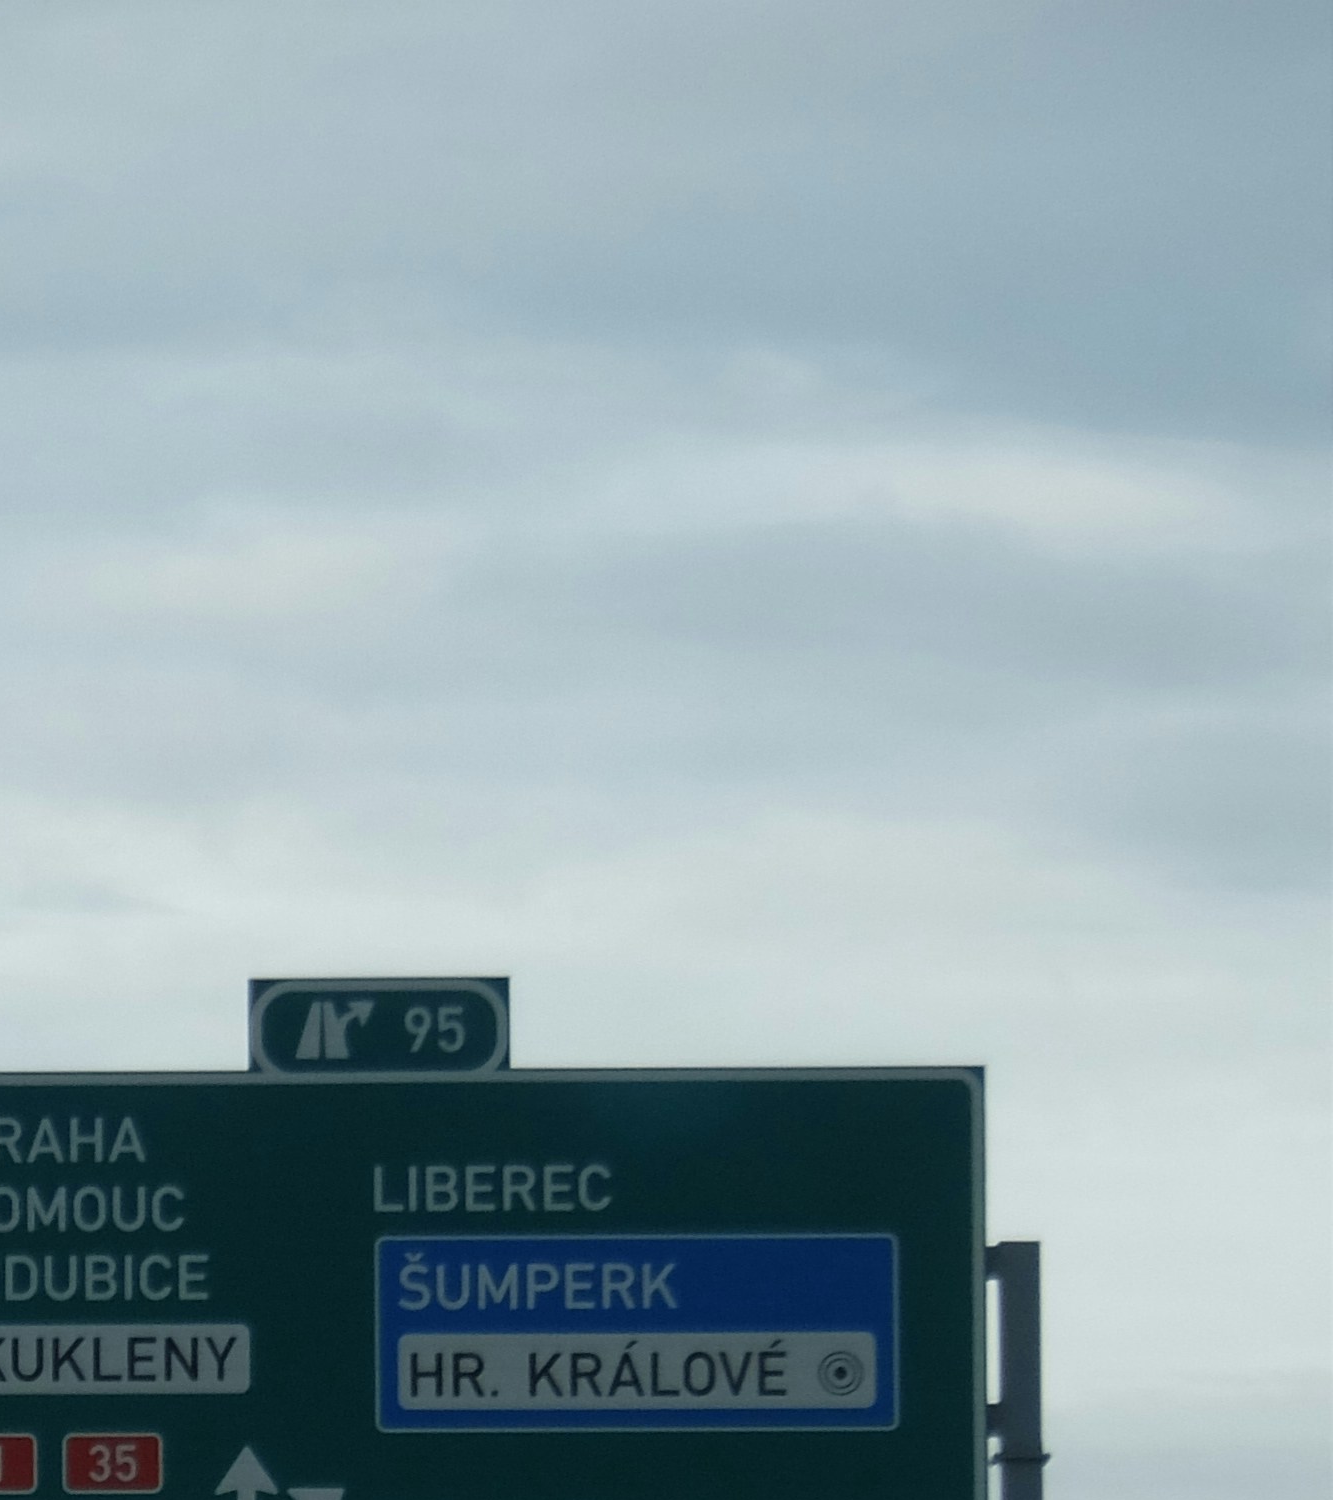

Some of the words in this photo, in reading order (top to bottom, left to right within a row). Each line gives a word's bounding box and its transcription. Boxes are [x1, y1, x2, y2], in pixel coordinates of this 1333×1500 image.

[404, 1006, 466, 1053] 95
[372, 1164, 613, 1213] LIBEREC
[397, 1252, 679, 1311] ŠUMPERK
[408, 1351, 501, 1399] HR.
[527, 1339, 789, 1399] KRÁLOVÉ
[88, 1444, 138, 1482] 35
